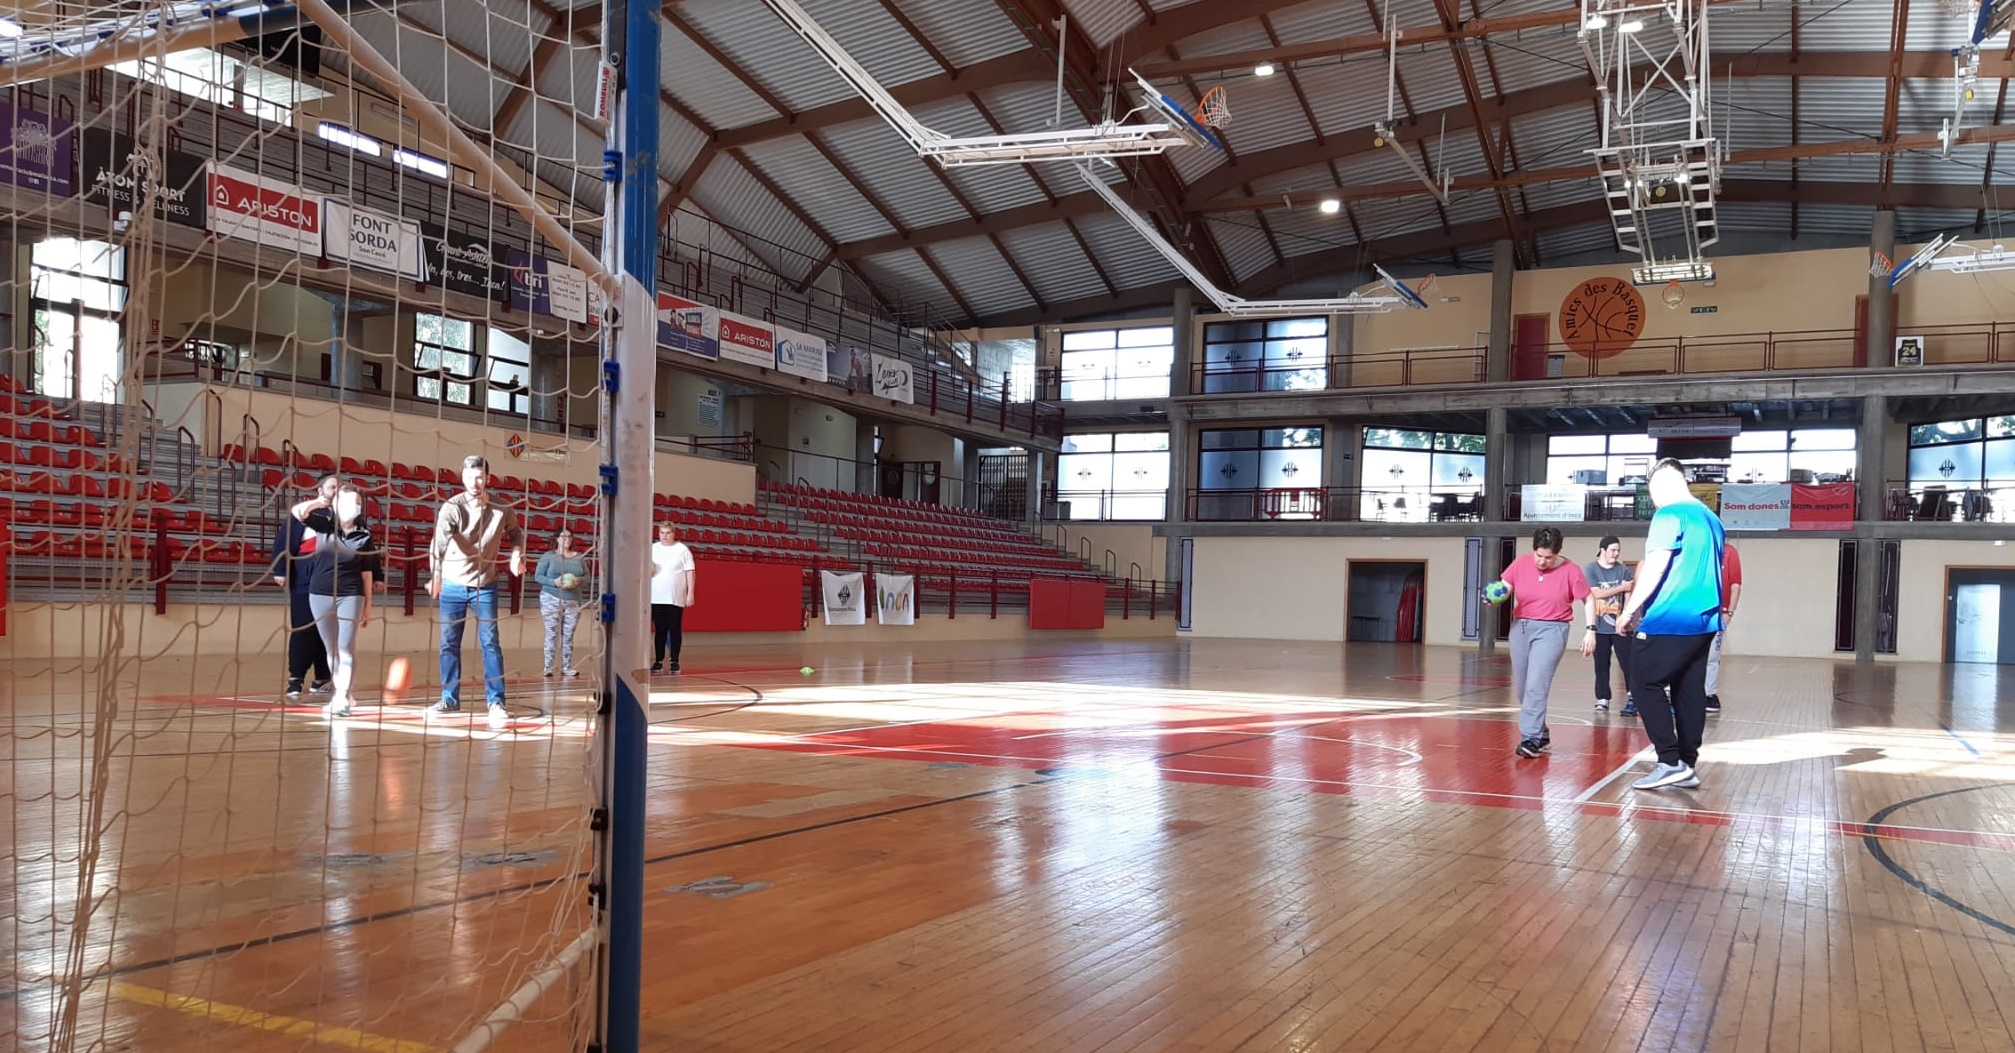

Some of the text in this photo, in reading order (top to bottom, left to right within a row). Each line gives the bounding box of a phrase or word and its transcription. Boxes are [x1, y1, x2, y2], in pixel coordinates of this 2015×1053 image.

[92, 184, 131, 202] FITNESS
[150, 200, 190, 216] ELLNESS
[141, 181, 187, 203] SPORT
[237, 197, 312, 227] ARISTON
[353, 213, 392, 235] FONT
[350, 228, 397, 253] SORDA
[1563, 297, 1582, 340] Amics
[1584, 283, 1608, 298] des
[733, 332, 772, 350] ARISTON
[1902, 346, 1916, 356] 24
[1724, 502, 1780, 511] Som dones
[1815, 502, 1850, 512] esport
[1715, 630, 1723, 651] adida
